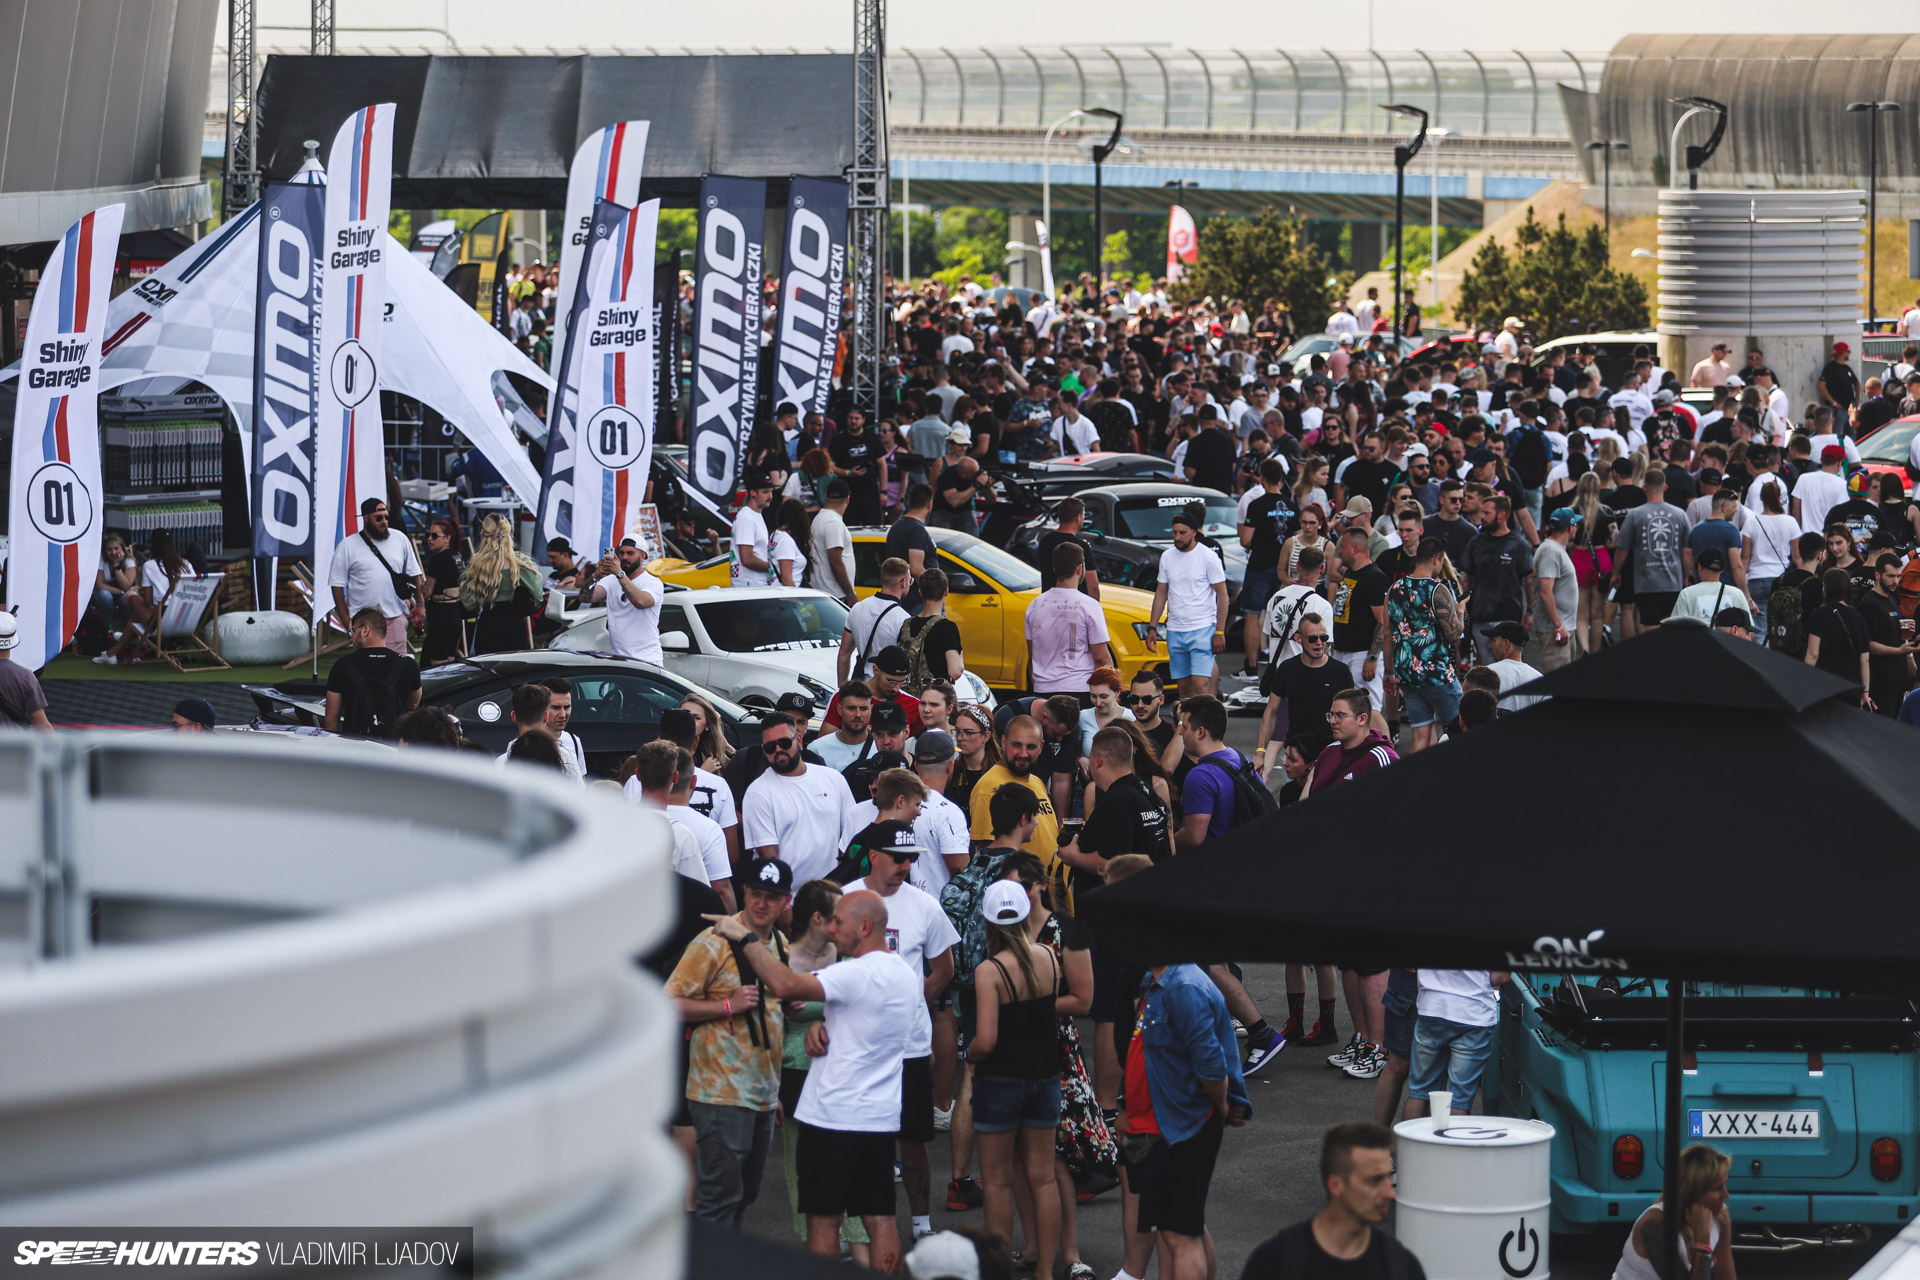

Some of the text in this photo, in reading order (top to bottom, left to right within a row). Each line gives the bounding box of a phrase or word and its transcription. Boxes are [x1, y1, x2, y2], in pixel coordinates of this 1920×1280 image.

[338, 226, 376, 248] Shiny
[331, 248, 381, 270] Garage
[743, 242, 762, 358] WYCIERACZKI
[822, 243, 844, 357] WYCIERACZKI
[598, 309, 640, 328] Shiny
[776, 208, 830, 445] XIMO
[590, 328, 647, 348] Garage
[40, 339, 89, 366] Shiny
[695, 208, 746, 497] OXIMO
[29, 364, 91, 389] Garage
[262, 220, 310, 546] OXIMO
[600, 420, 629, 455] 01
[44, 480, 76, 526] 01
[1504, 951, 1629, 971] LEMON
[1693, 1113, 1813, 1135] H XXX-444
